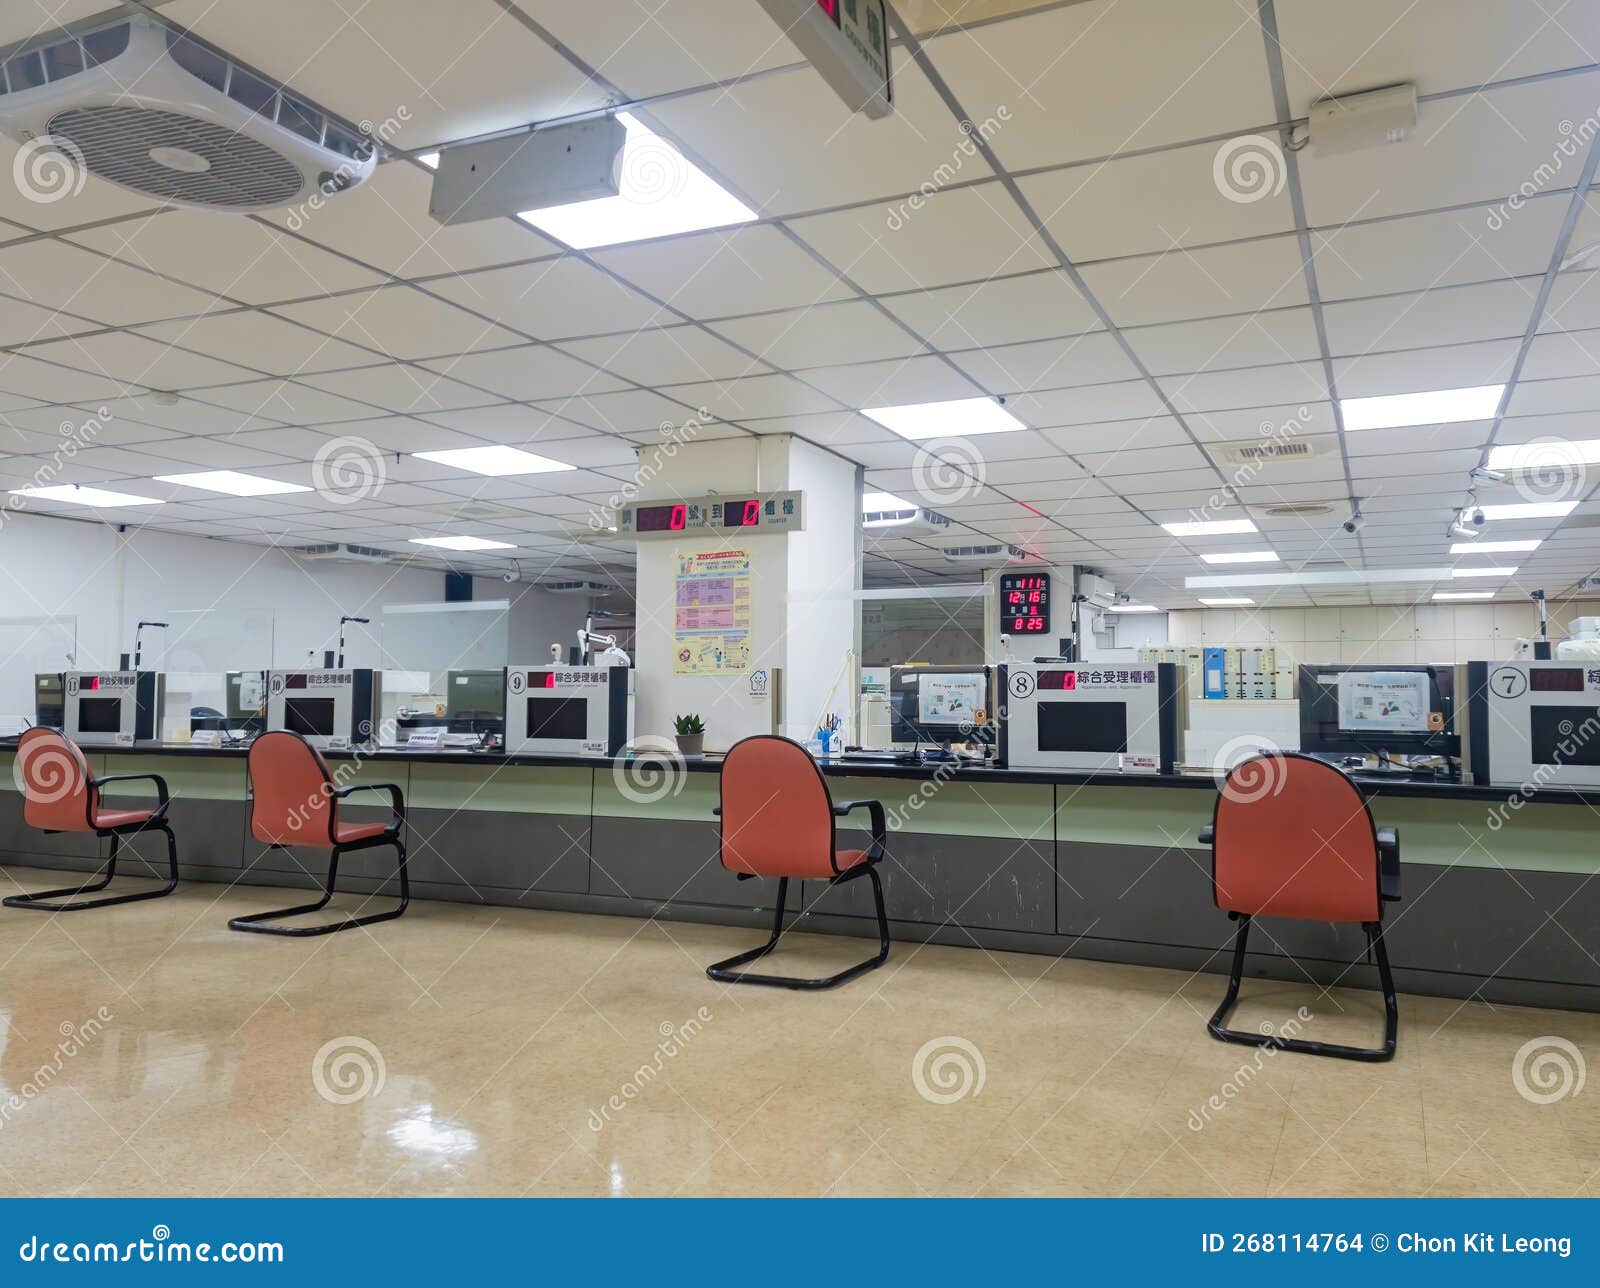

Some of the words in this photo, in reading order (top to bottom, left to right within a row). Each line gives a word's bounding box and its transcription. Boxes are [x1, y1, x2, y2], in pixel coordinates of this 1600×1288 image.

[669, 504, 687, 530] 0
[742, 500, 760, 527] 0
[1021, 577, 1041, 589] 111
[1009, 591, 1021, 603] 12
[1015, 618, 1023, 630] 8
[1027, 617, 1043, 630] 25
